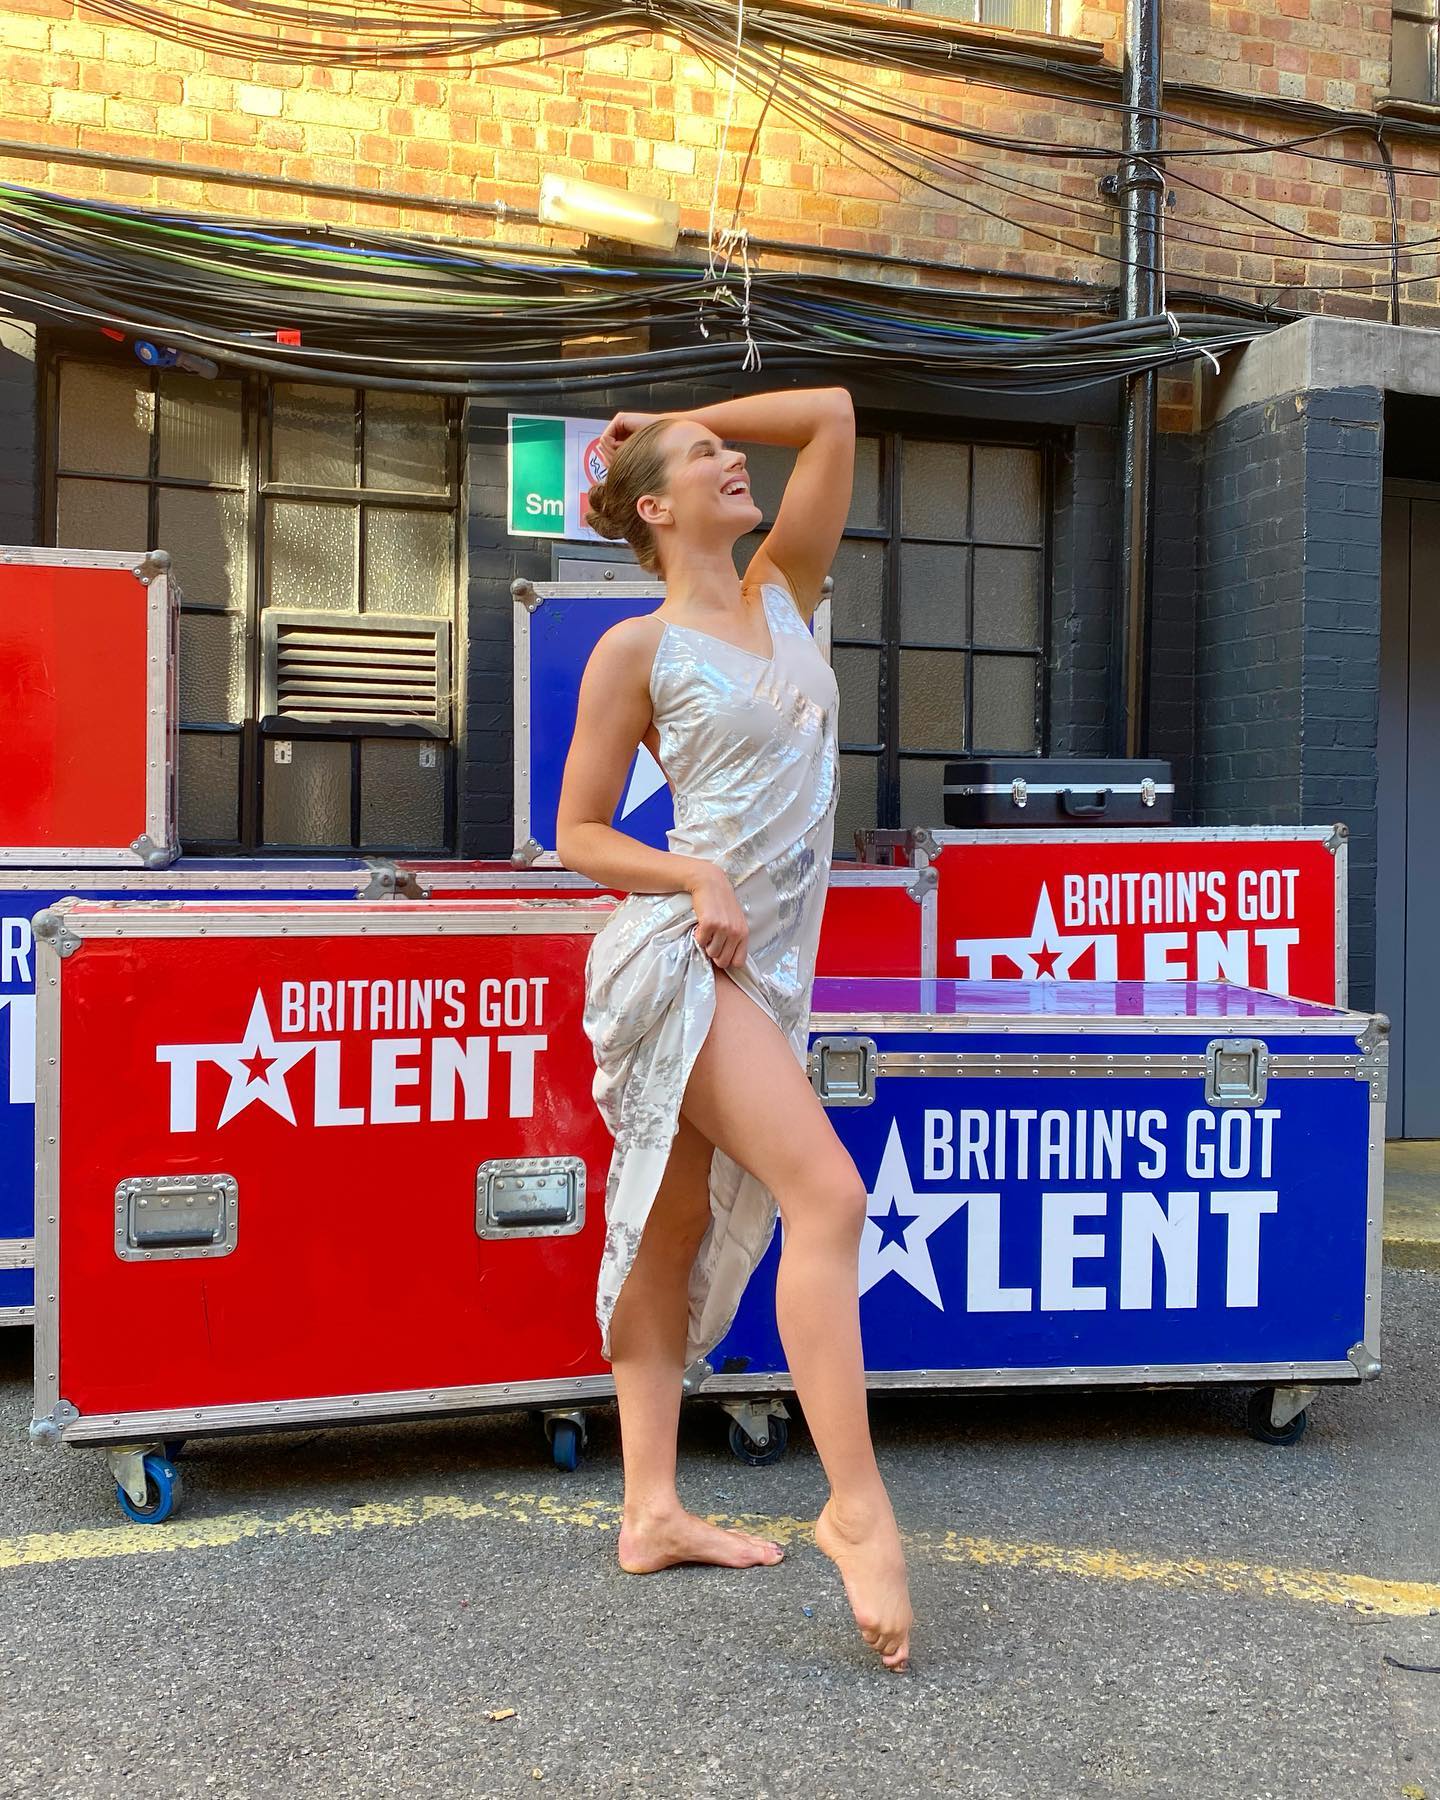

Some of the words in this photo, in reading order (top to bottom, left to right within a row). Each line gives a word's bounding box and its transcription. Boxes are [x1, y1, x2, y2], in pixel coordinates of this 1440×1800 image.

[1063, 871, 1227, 927] BRITAIN'S
[1237, 869, 1300, 921] GOT
[281, 979, 466, 1033] BRITAIN'S
[479, 977, 549, 1028] GOT
[155, 988, 548, 1133] TALENT
[923, 1109, 1167, 1180] BRITAIN'S
[1186, 1109, 1282, 1179] GOT
[858, 1116, 1279, 1313] ALENT
